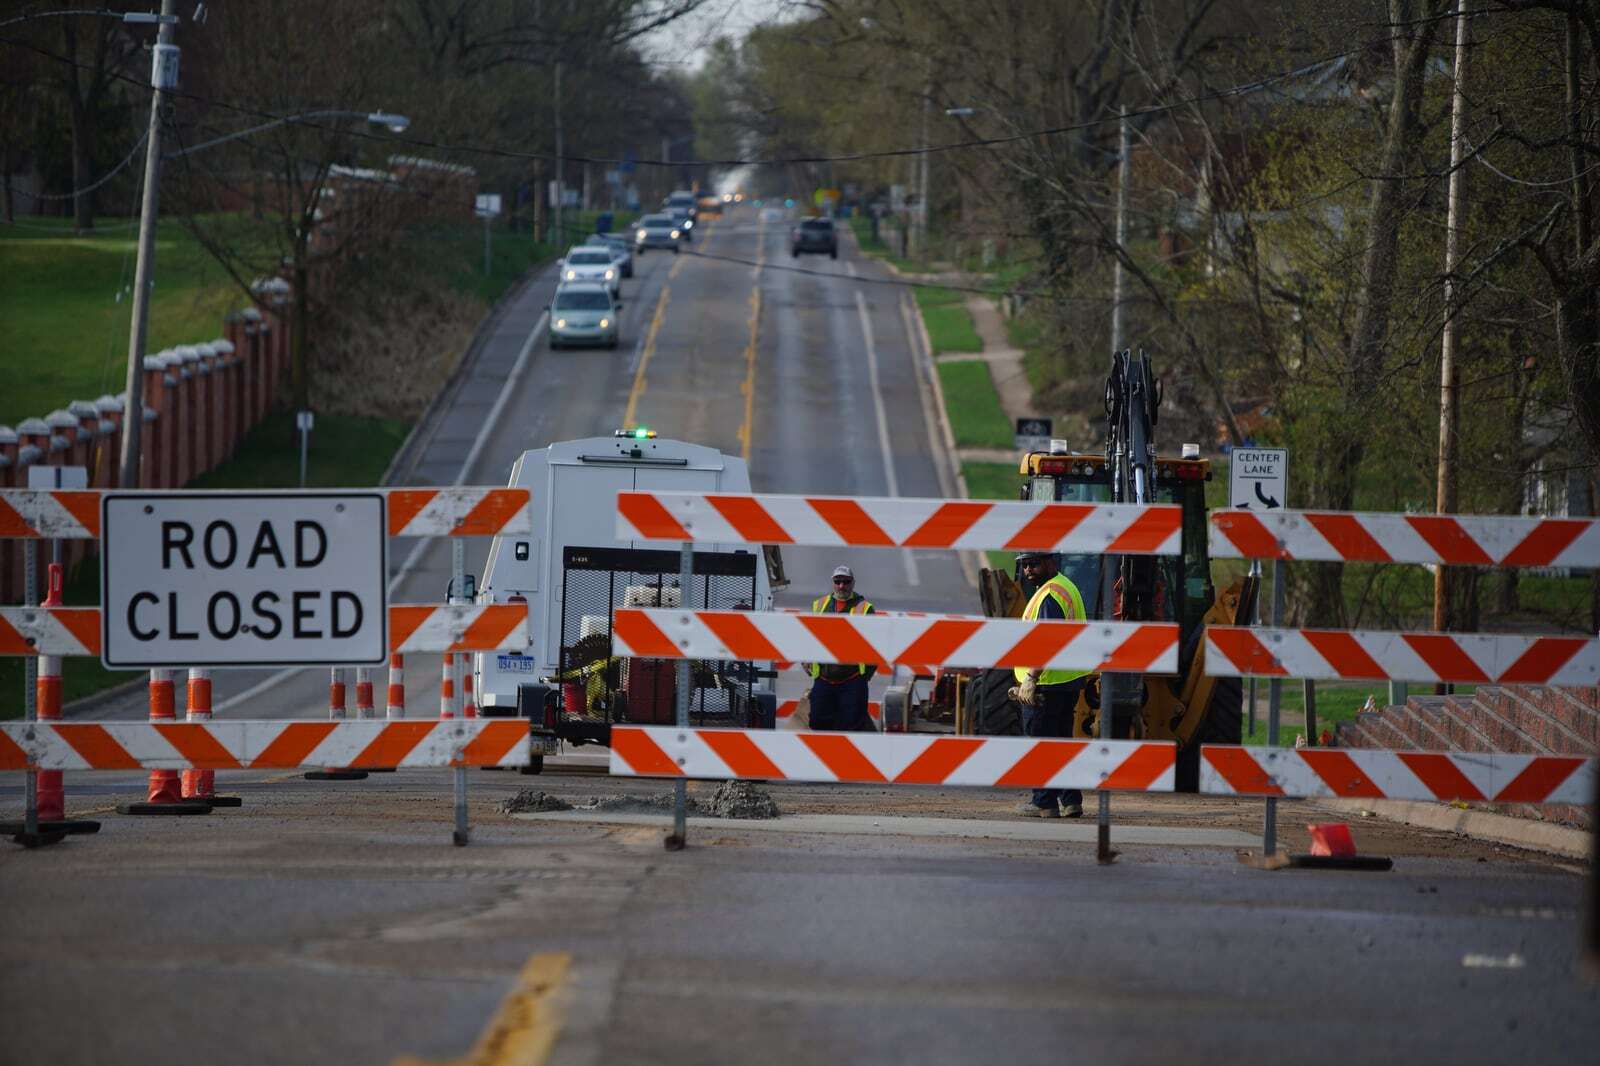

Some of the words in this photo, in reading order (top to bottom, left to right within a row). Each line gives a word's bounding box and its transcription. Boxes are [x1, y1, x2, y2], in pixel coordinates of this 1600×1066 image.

[1238, 453, 1280, 462] CENTER
[1244, 465, 1273, 474] LANE
[161, 520, 328, 570] ROAD
[127, 591, 364, 641] CLOSED
